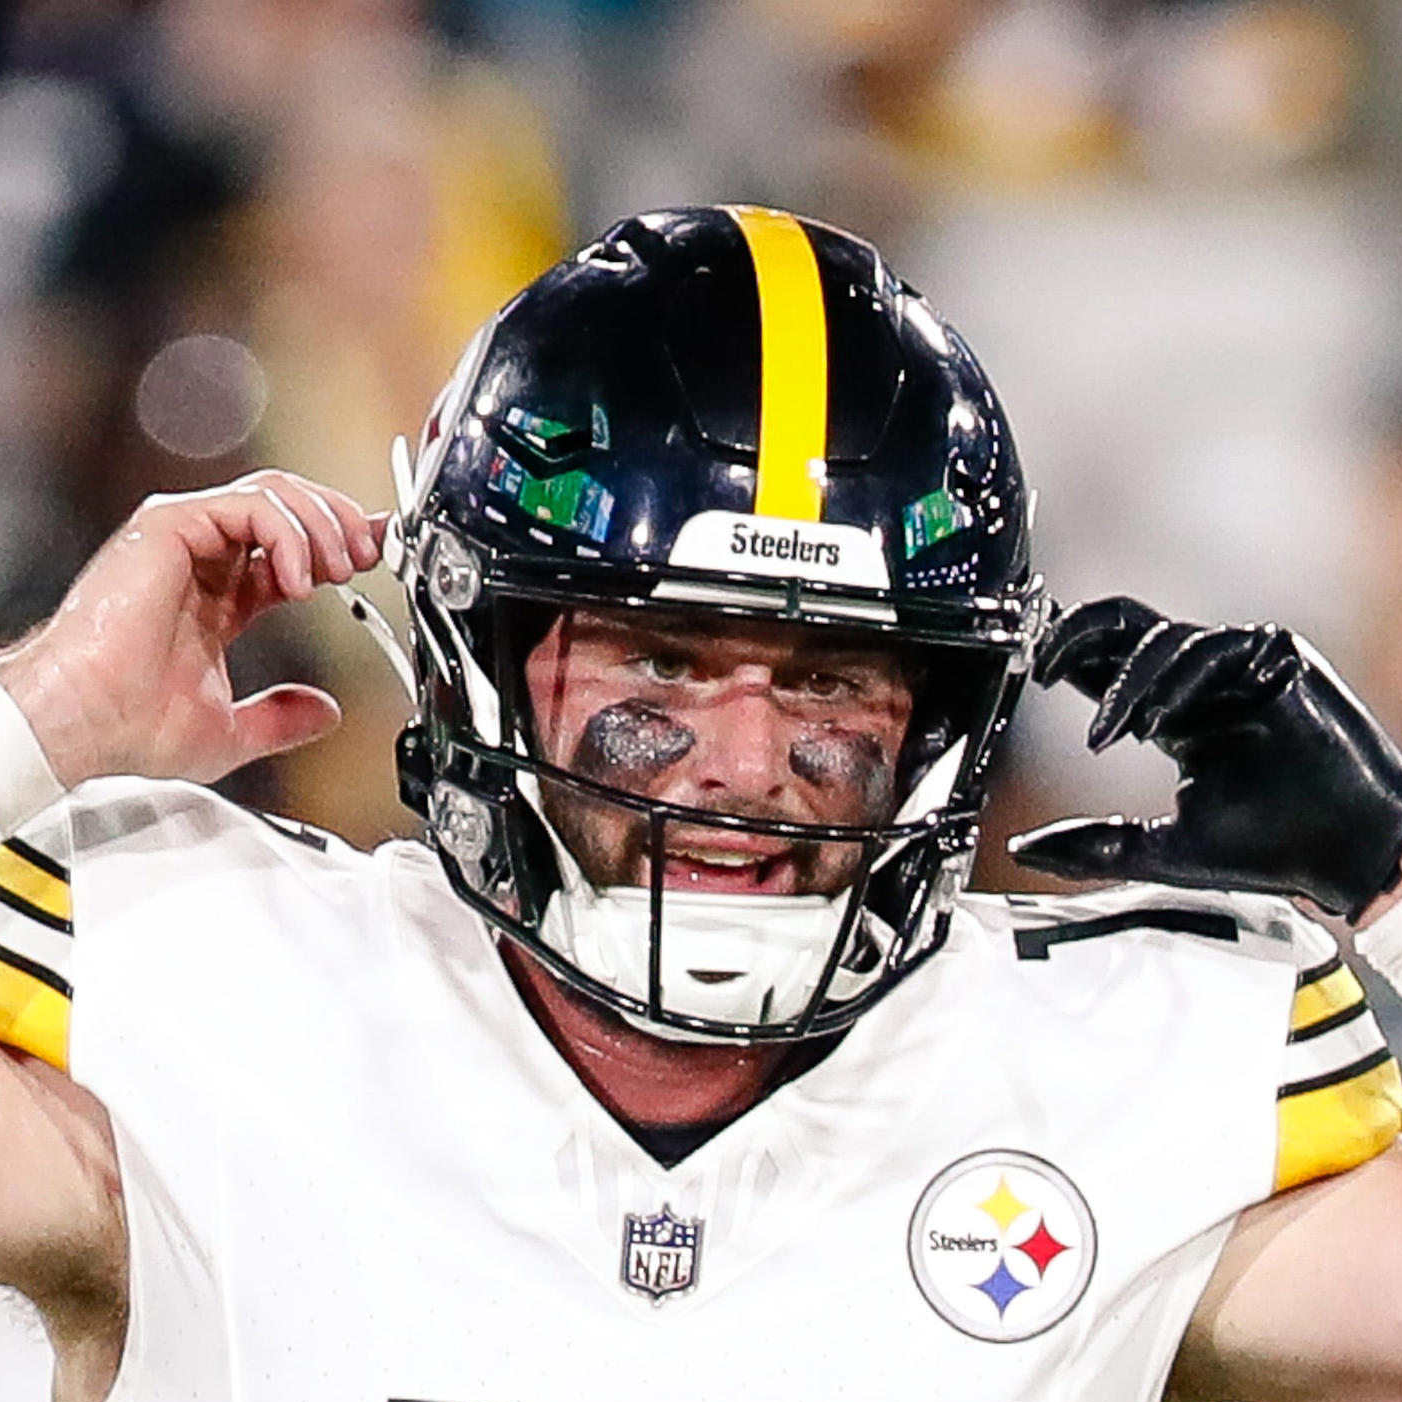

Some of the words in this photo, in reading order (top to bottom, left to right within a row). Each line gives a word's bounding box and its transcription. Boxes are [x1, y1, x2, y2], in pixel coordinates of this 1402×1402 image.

[730, 522, 841, 567] Steelers
[929, 1229, 999, 1253] Steelers
[629, 1249, 688, 1289] NFL
